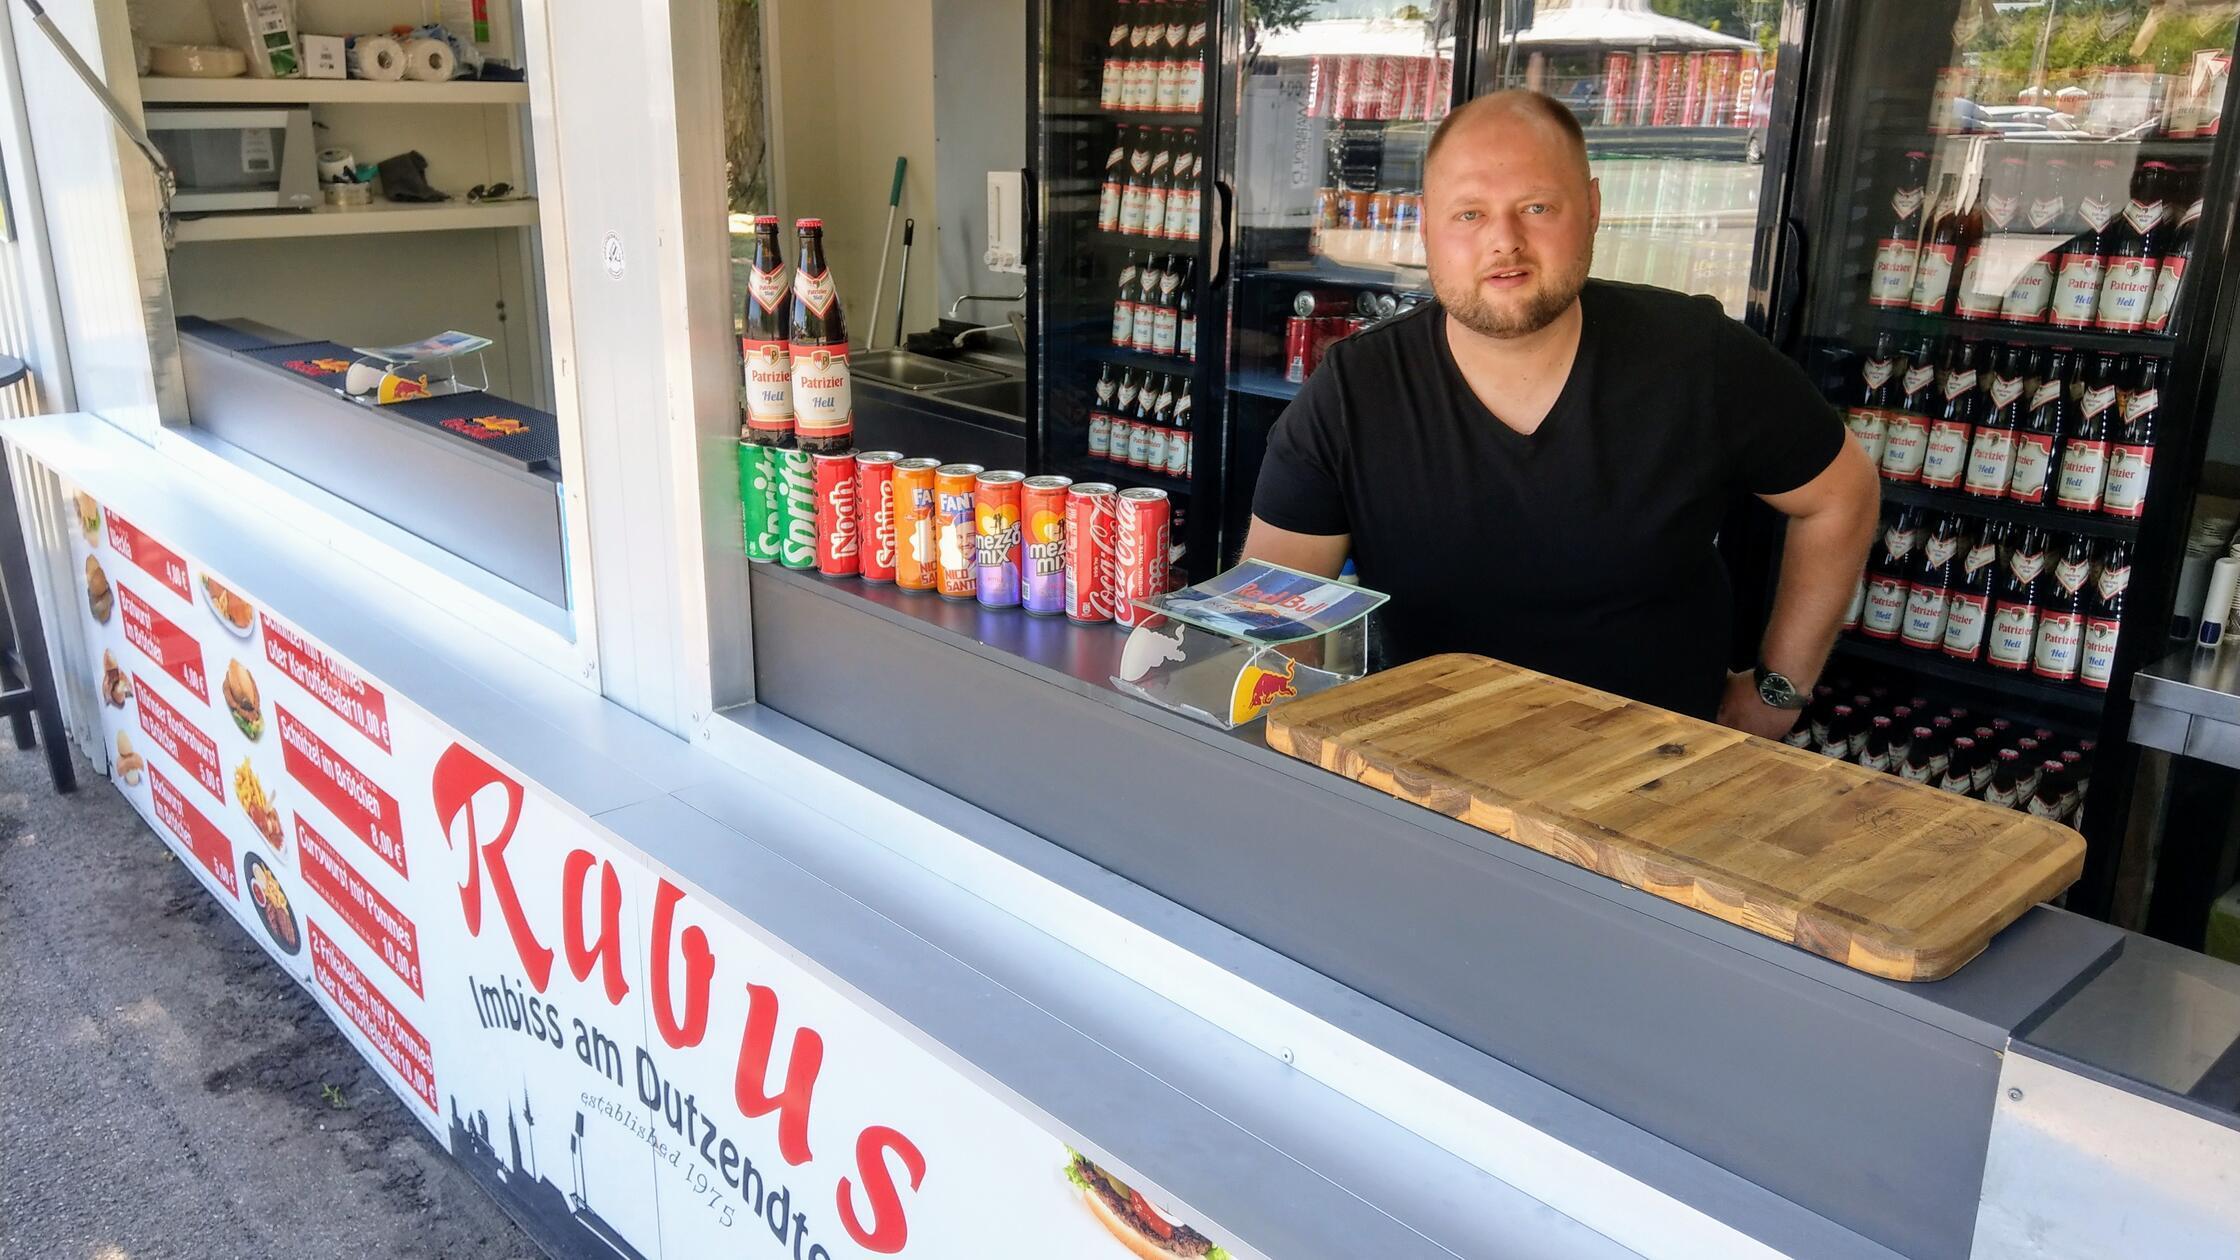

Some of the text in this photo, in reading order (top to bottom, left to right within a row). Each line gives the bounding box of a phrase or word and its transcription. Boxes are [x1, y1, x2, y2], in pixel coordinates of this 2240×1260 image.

[2068, 279, 2099, 290] Patrizie
[2110, 280, 2149, 293] Patrizier
[2116, 297, 2135, 307] Hell
[752, 370, 791, 382] Patrizie
[801, 377, 844, 389] Patrizier
[762, 390, 784, 401] Hell
[812, 397, 835, 408] Hell
[1855, 431, 1881, 441] atrizier
[1889, 436, 1918, 447] atrizier
[779, 452, 817, 567] Sprite
[830, 477, 858, 559] Noah
[945, 569, 969, 580] NICO
[1280, 594, 1329, 614] Bull
[267, 639, 288, 670] oder
[2089, 656, 2105, 667] Hell
[280, 715, 382, 820] Schnitzel im Brötchen
[370, 822, 403, 868] 8,00 €
[298, 825, 349, 891] Currywurst
[349, 877, 366, 908] mit
[366, 890, 412, 952] Pommes
[382, 936, 420, 989] 10,00 €
[316, 965, 336, 998] oder
[311, 932, 320, 953] 2
[319, 937, 369, 1004] Frikadellen
[370, 991, 387, 1023] mit
[387, 1011, 433, 1075] Pommes
[432, 742, 926, 1254] Rabus
[468, 974, 563, 1049] Imbiss
[573, 1017, 624, 1088] am
[580, 1090, 737, 1228] established 1975
